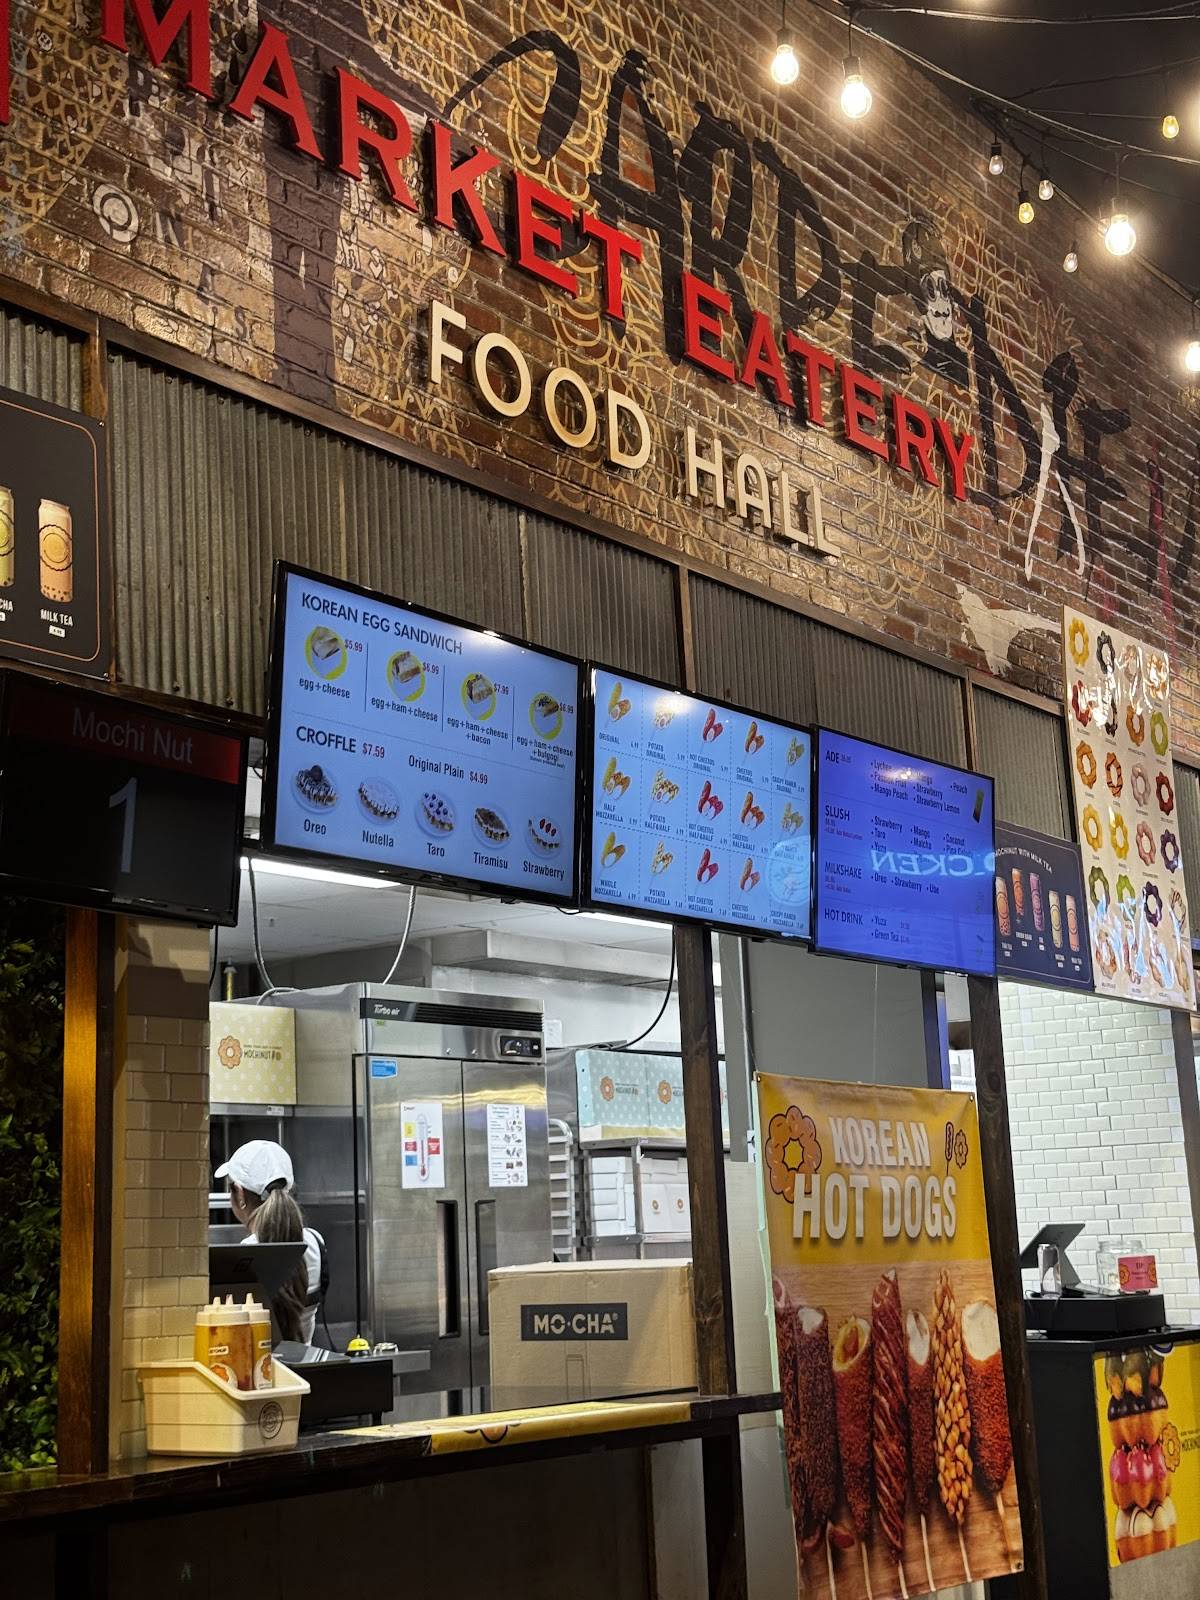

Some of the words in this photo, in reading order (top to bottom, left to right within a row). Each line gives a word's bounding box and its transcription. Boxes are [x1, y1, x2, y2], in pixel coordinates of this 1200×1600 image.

[101, 0, 641, 321] MARKET
[681, 272, 975, 501] EATERY
[429, 300, 651, 470] FOOD
[687, 426, 841, 557] HALL
[40, 609, 59, 623] MILK
[59, 613, 73, 627] TEA
[302, 592, 358, 623] KOREAN
[362, 612, 390, 632] EGG
[394, 622, 462, 655] SANDWICH
[345, 639, 363, 652] $5.99
[72, 707, 145, 752] Mochi
[153, 728, 194, 764] Nut
[296, 726, 356, 753] CROFFLE
[362, 742, 385, 758] $7.59
[825, 750, 840, 763] ADE
[408, 755, 441, 773] Original
[444, 763, 464, 780] Plain
[470, 771, 488, 784] $4.99
[825, 805, 850, 821] SLUSH
[109, 777, 139, 873] 1
[304, 819, 327, 835] Oreo
[362, 830, 394, 847] Nutella
[427, 843, 445, 857] Taro
[473, 851, 508, 869] Tiramisu
[523, 861, 565, 881] Strawberry
[825, 861, 862, 880] MILKSHAKE
[824, 908, 839, 921] HOT
[841, 910, 863, 925] DRINK
[874, 930, 890, 941] Green
[374, 1004, 391, 1015] Turbo
[391, 1008, 400, 1016] air
[828, 1116, 931, 1168] KOREAN
[792, 1173, 870, 1240] HOT
[881, 1174, 957, 1239] DOGS
